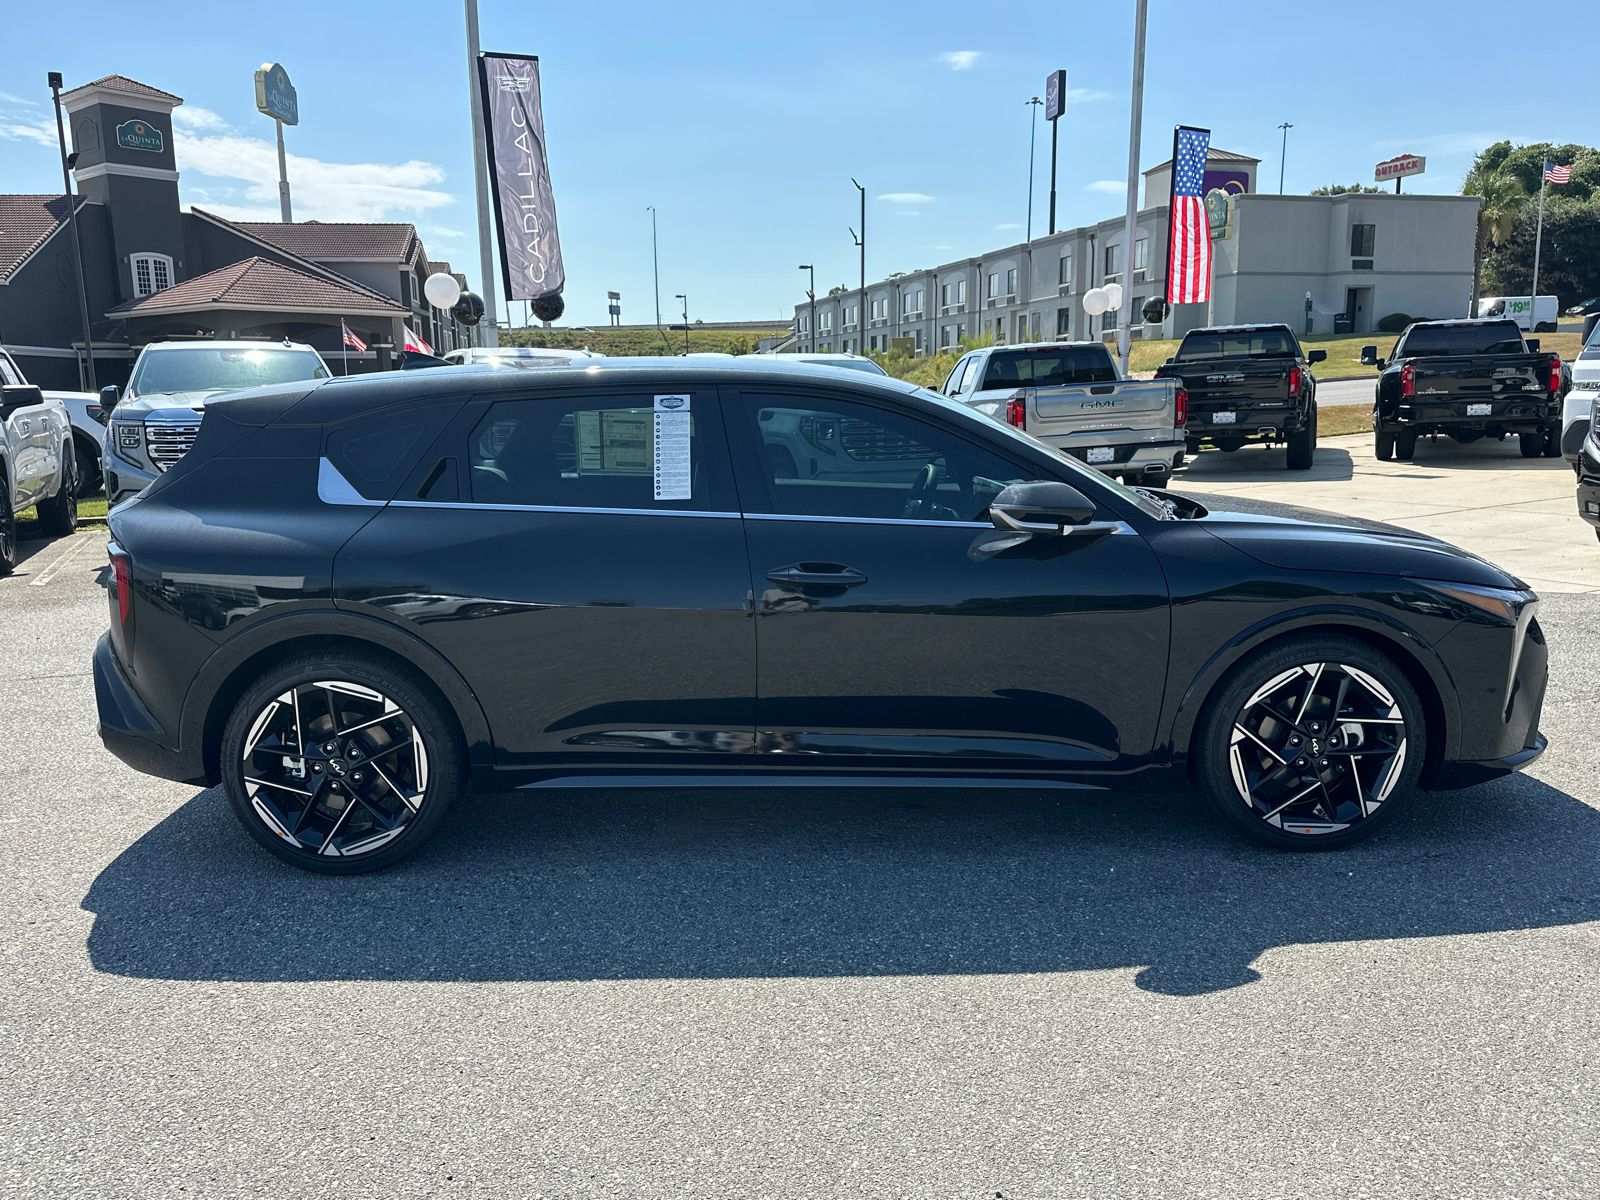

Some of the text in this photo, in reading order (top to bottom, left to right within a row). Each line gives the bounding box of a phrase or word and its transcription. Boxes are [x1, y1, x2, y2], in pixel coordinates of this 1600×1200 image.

[272, 90, 297, 114] QUINTA
[127, 134, 161, 146] QUINTA
[1375, 160, 1418, 177] OUTBACK
[510, 105, 545, 284] CADILLAC
[1206, 373, 1245, 383] GMC
[1080, 400, 1126, 411] GMC
[350, 669, 381, 683] 235/40
[381, 680, 398, 693] R18
[1404, 734, 1421, 788] KUMHO
